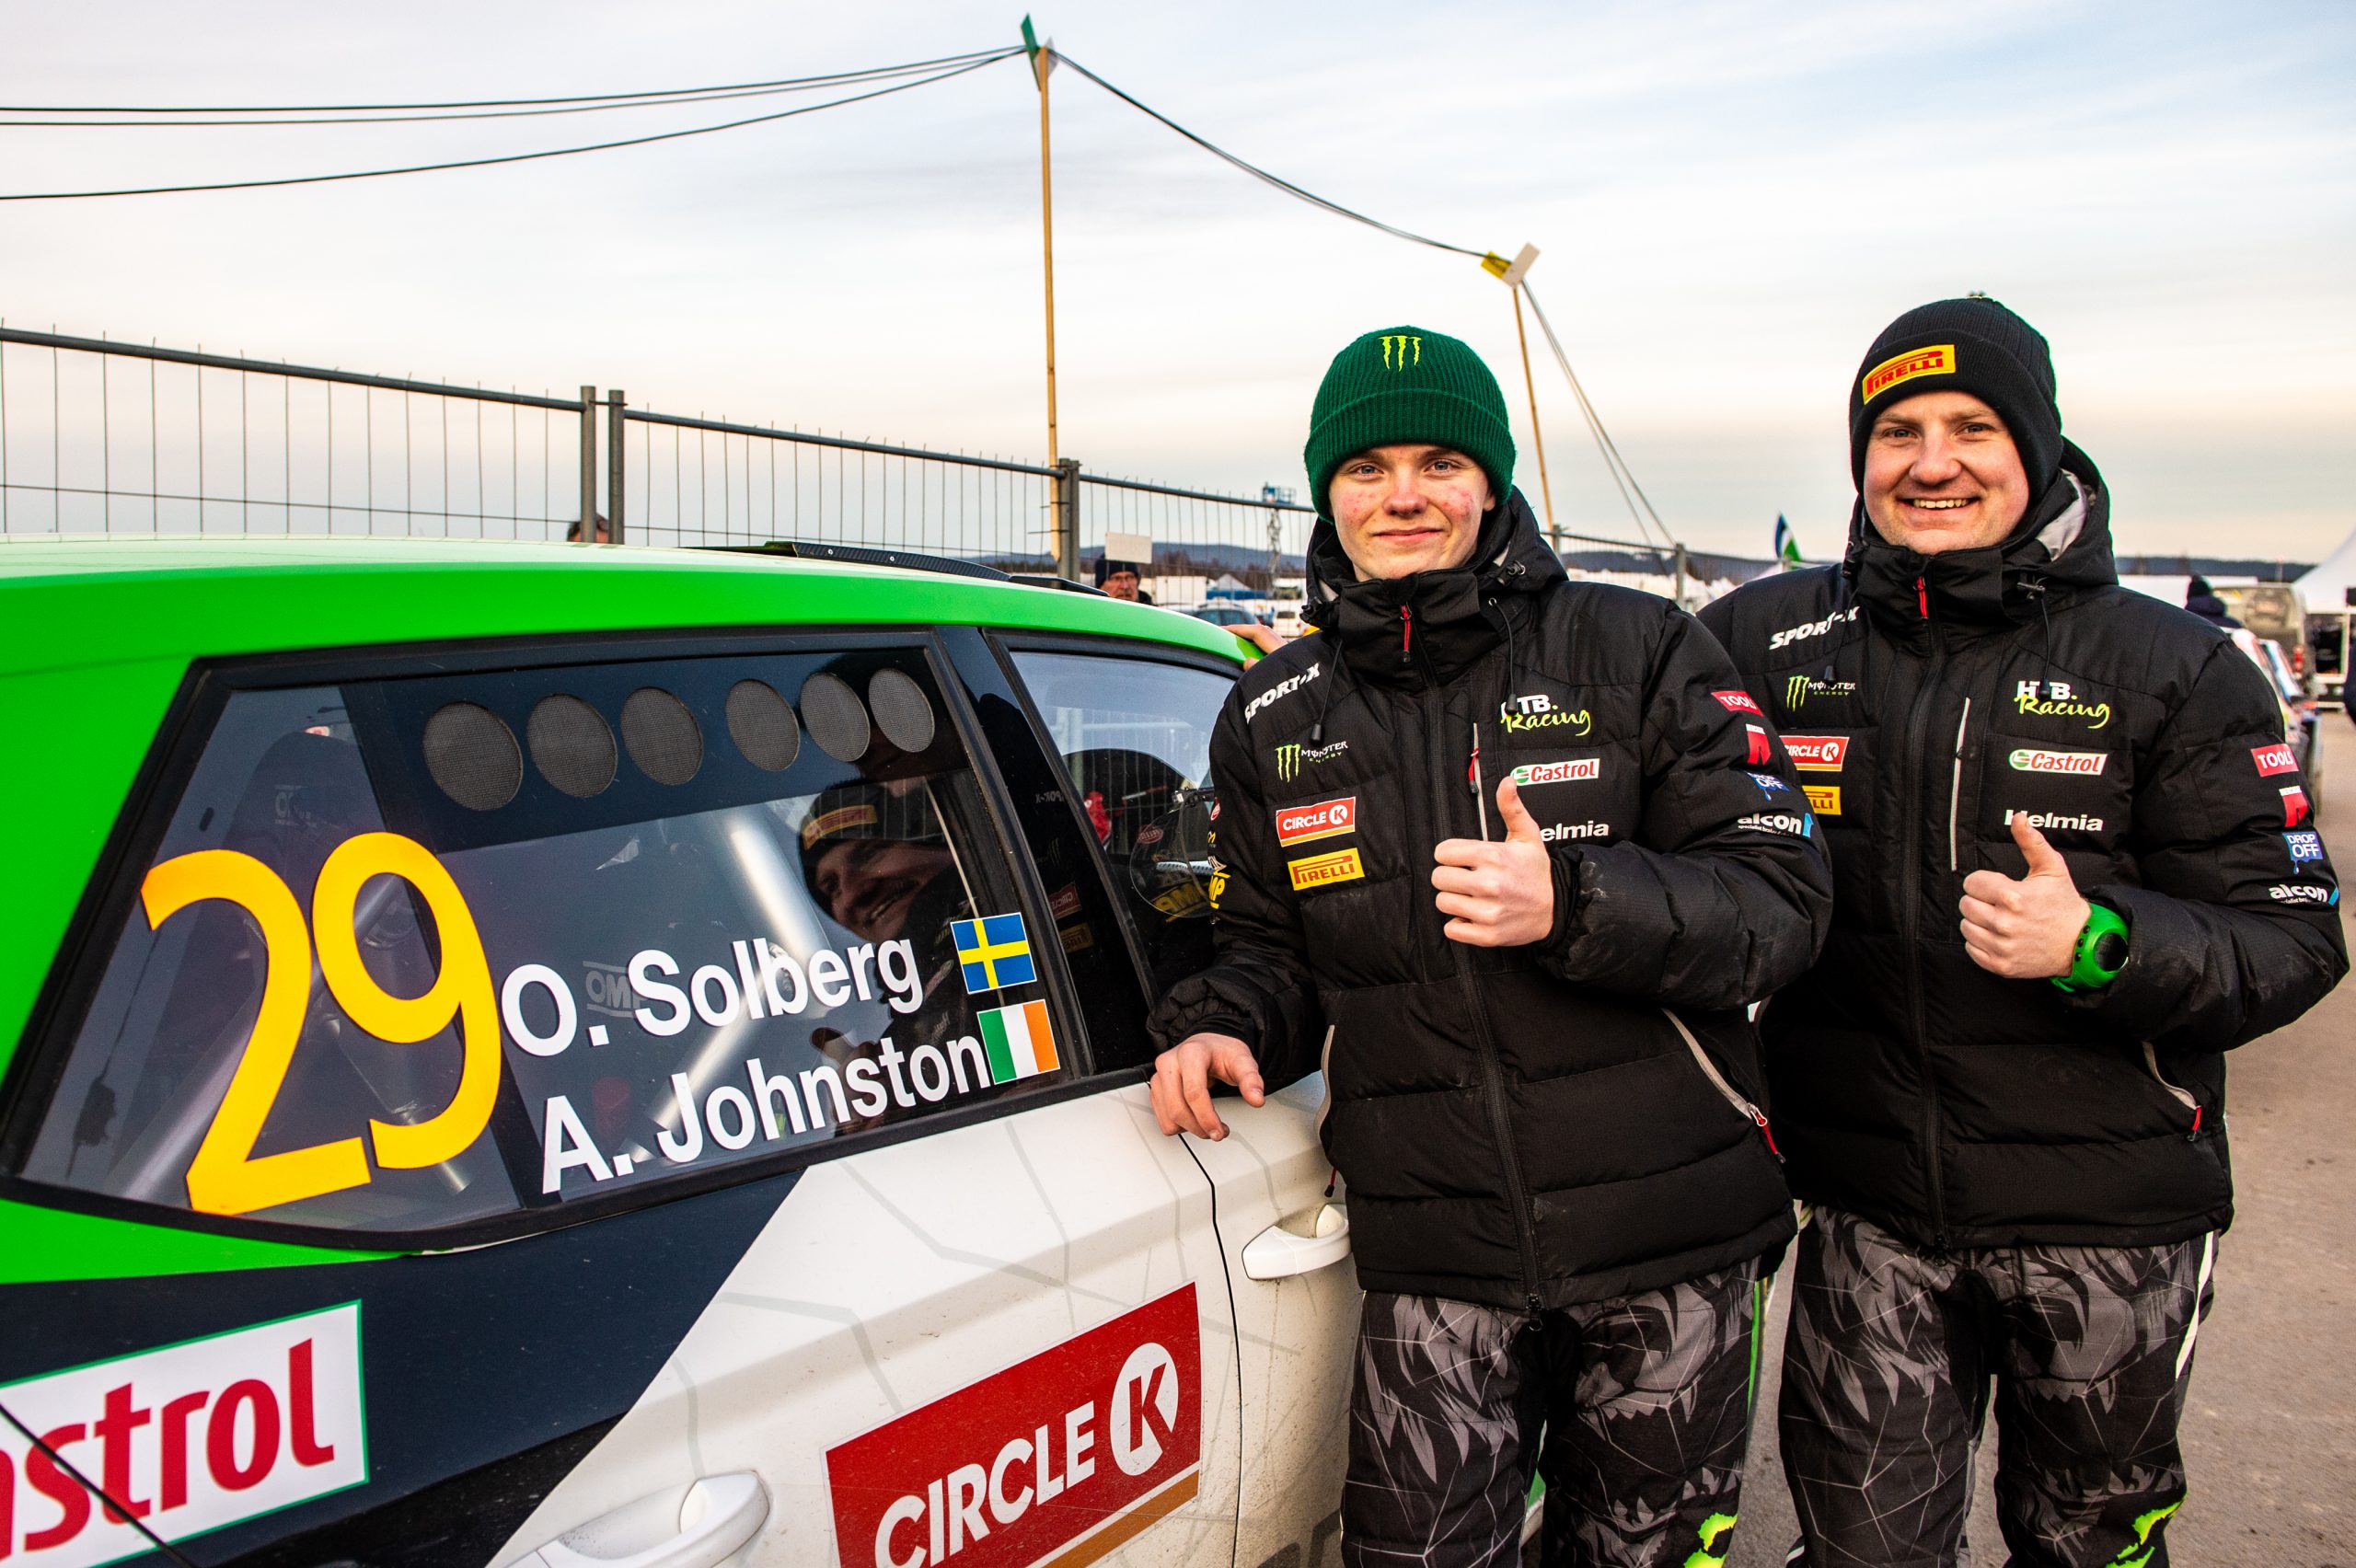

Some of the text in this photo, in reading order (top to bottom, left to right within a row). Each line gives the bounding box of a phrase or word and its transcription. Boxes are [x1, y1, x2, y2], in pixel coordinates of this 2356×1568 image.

[1866, 351, 1943, 396] PIRELLI
[1501, 694, 1552, 719] TB
[2014, 694, 2110, 729] Racing
[1500, 704, 1591, 736] Racing
[1784, 744, 1838, 760] IRCLE K
[2031, 753, 2100, 772] Castrol
[2258, 751, 2293, 769] TOOLS
[1530, 761, 1596, 782] Castrol
[1282, 807, 1346, 831] CIRCLE K
[1541, 820, 1610, 842] elmia
[1738, 813, 1802, 835] alcon
[2287, 834, 2316, 844] DROP
[2292, 844, 2319, 858] OFF
[1292, 855, 1355, 884] PIRELLI
[2269, 884, 2328, 902] alcon
[502, 963, 611, 1056] O.
[628, 937, 922, 1037] Solberg
[140, 831, 502, 1217] 29
[542, 1033, 991, 1194] A. Johnston
[874, 1351, 1178, 1568] CIRCLE K
